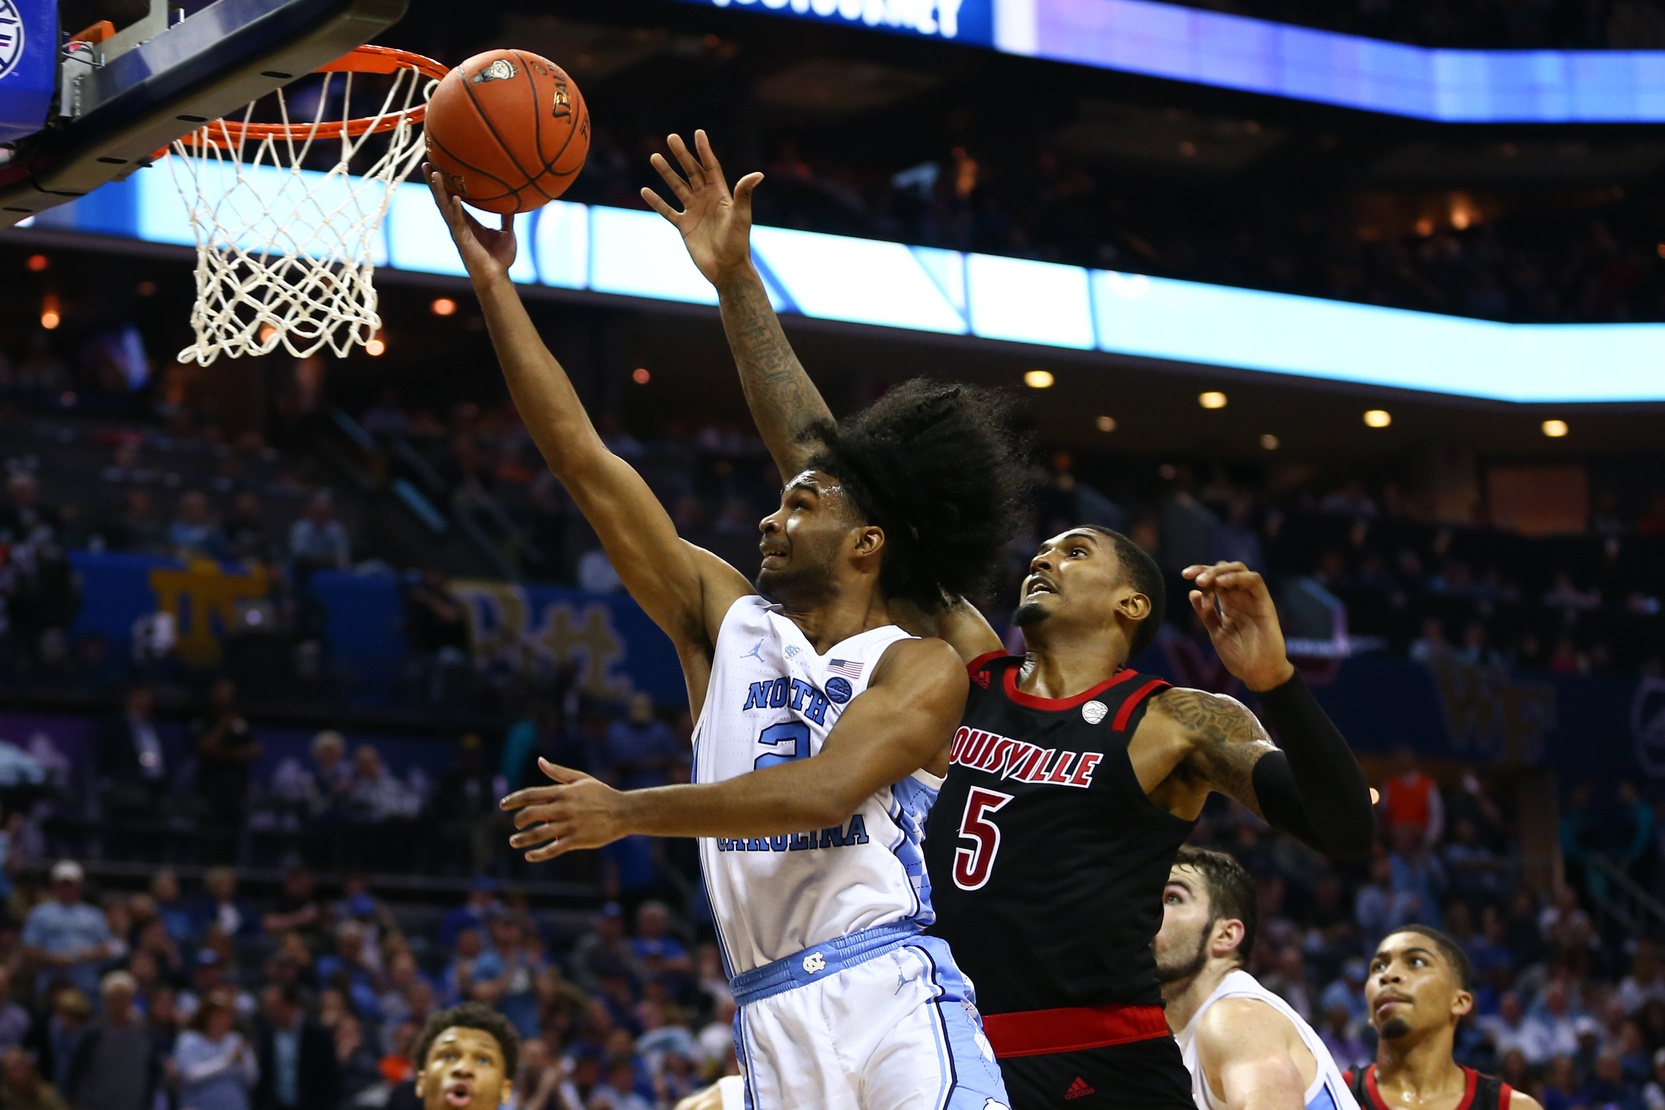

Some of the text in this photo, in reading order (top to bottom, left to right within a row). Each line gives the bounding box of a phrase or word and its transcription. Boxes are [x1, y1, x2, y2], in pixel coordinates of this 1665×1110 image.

[742, 676, 831, 727] NOTH
[754, 721, 811, 771] 2
[949, 725, 1104, 789] OUISVILLE
[952, 785, 1014, 891] 5
